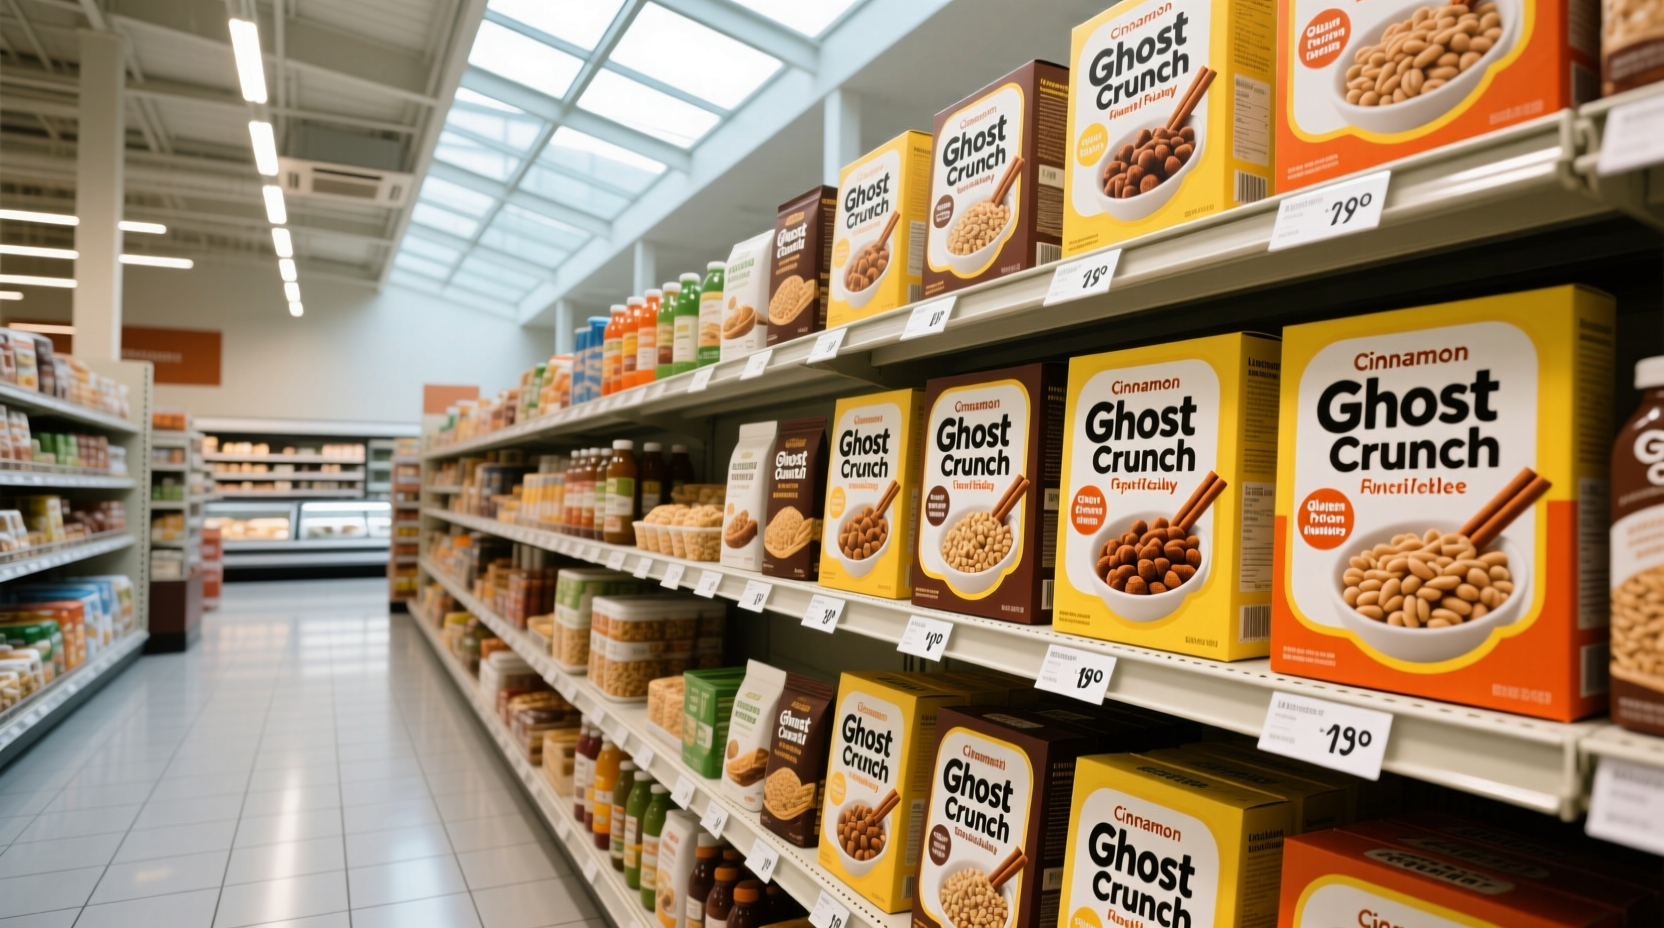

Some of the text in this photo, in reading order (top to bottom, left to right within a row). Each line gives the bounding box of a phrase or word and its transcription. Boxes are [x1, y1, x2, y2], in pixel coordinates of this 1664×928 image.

[1111, 2, 1172, 40] Cinnamon
[1089, 11, 1189, 87] Ghost
[1096, 48, 1190, 110] Crunch
[942, 114, 1007, 167] Ghost
[946, 143, 1006, 187] Crunch
[844, 172, 890, 212] Ghost
[1353, 346, 1469, 372] Cinnamon
[1111, 377, 1181, 395] Cinnamon
[1316, 368, 1500, 434] Ghost
[936, 413, 1011, 452] Ghost
[1085, 395, 1197, 443] Ghost
[839, 428, 890, 457] Ghost
[940, 449, 1010, 477] Crunch
[1092, 438, 1196, 475] Crunch
[1329, 426, 1500, 473] Crunch
[842, 713, 893, 758] Ghost
[943, 757, 1014, 814] Ghost
[945, 796, 1011, 844] Crunch
[1113, 805, 1182, 843] Cinnamon
[1088, 821, 1196, 899] Ghost
[1092, 870, 1192, 928] Crunch
